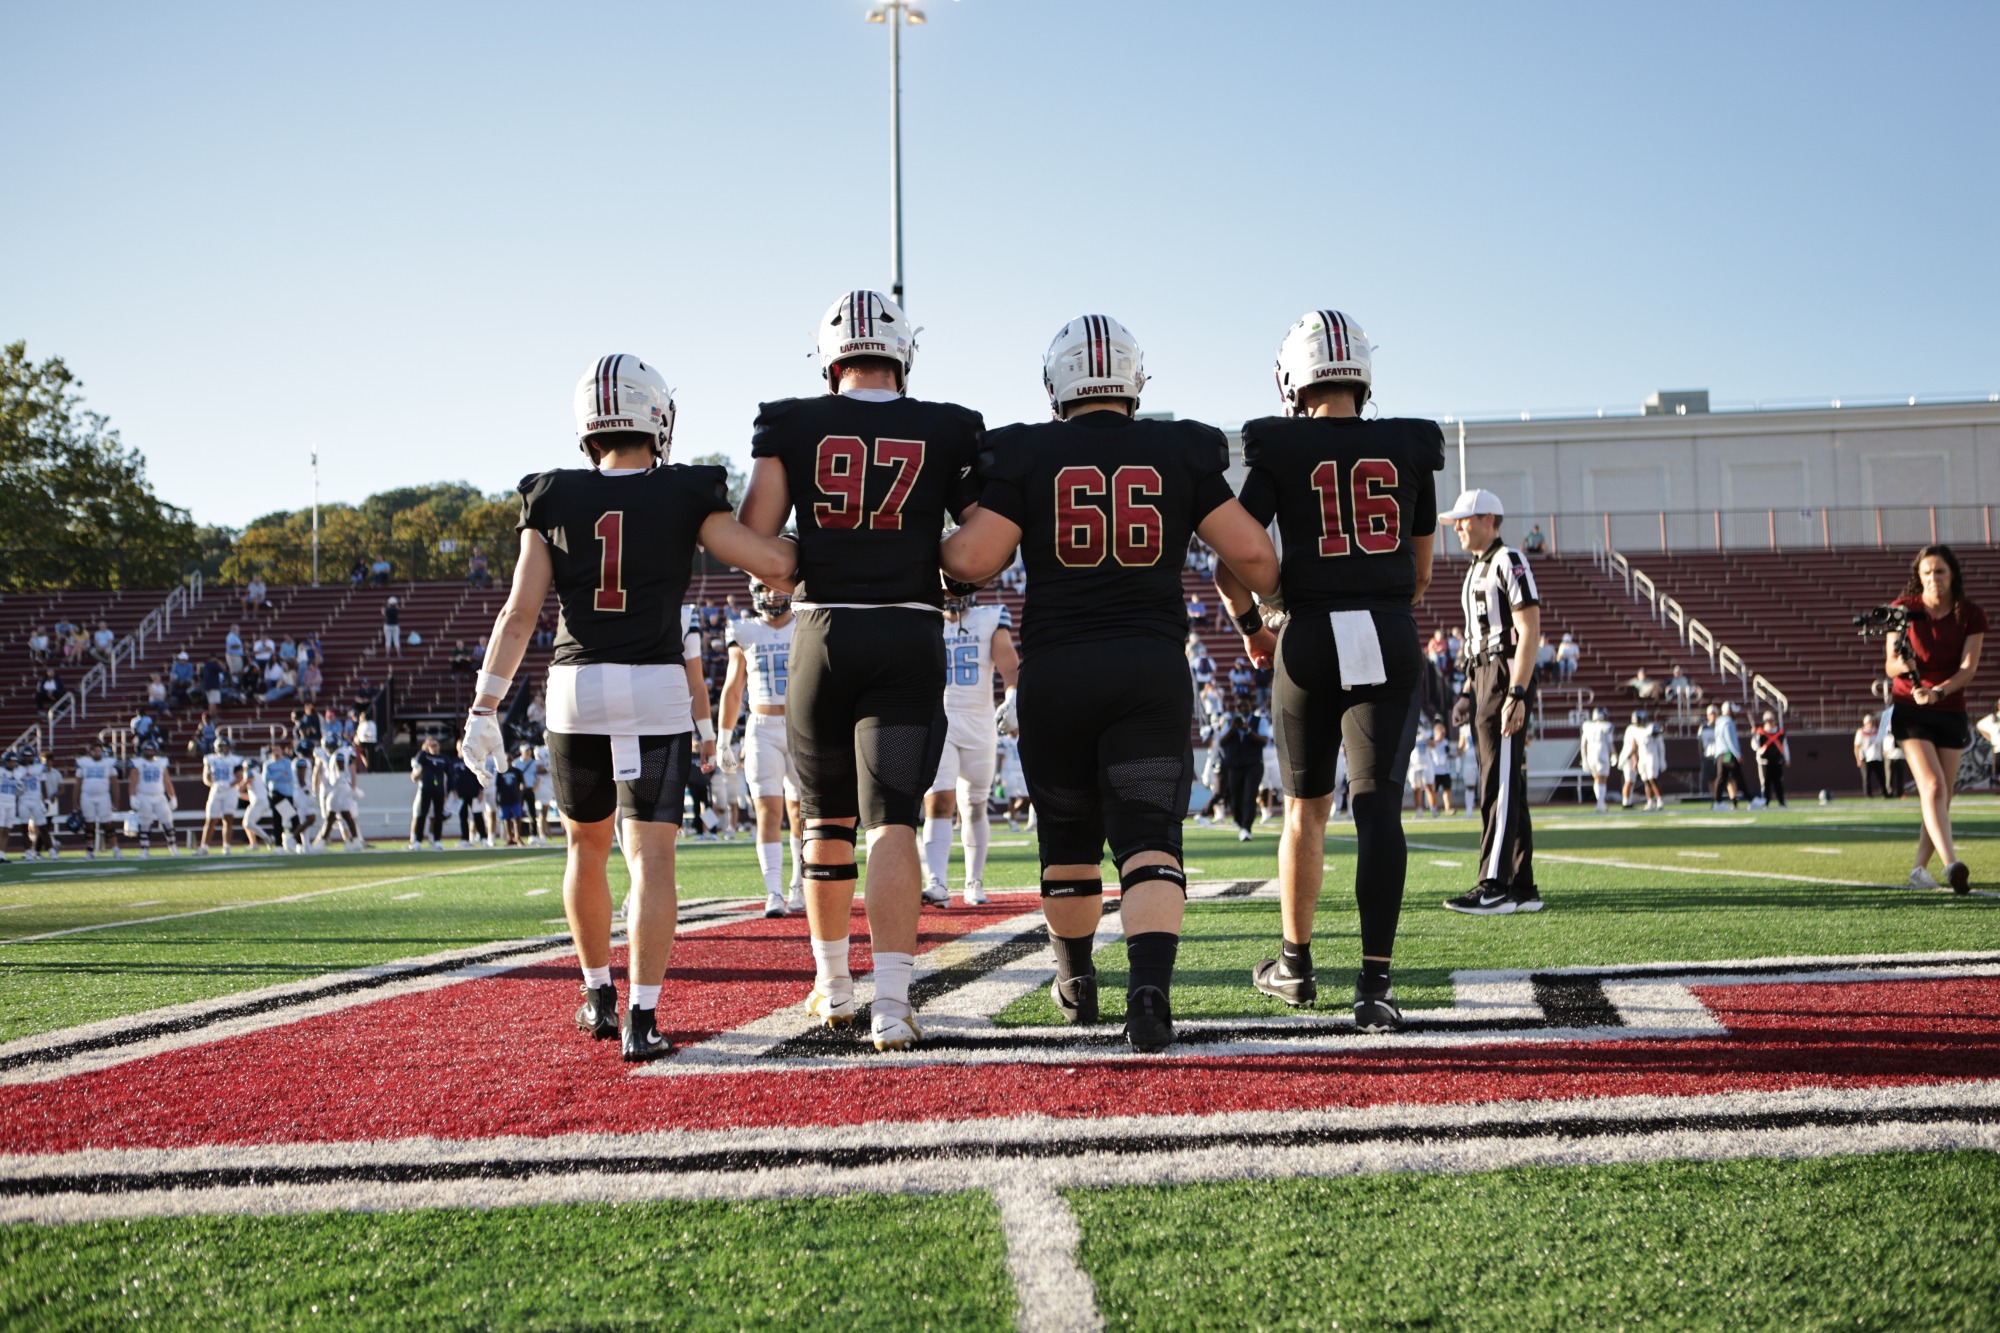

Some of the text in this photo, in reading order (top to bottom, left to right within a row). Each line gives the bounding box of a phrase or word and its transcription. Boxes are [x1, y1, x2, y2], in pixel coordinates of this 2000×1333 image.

[840, 341, 886, 353] LAFAYETTE
[1316, 367, 1362, 378] LAFAYETTE
[1077, 384, 1125, 396] LAFAYETTE
[587, 418, 634, 431] LAFAYETTE
[814, 435, 926, 530] 97
[1311, 458, 1401, 557] 16
[1054, 465, 1163, 567] 66
[593, 510, 627, 612] 1
[1476, 600, 1487, 616] R
